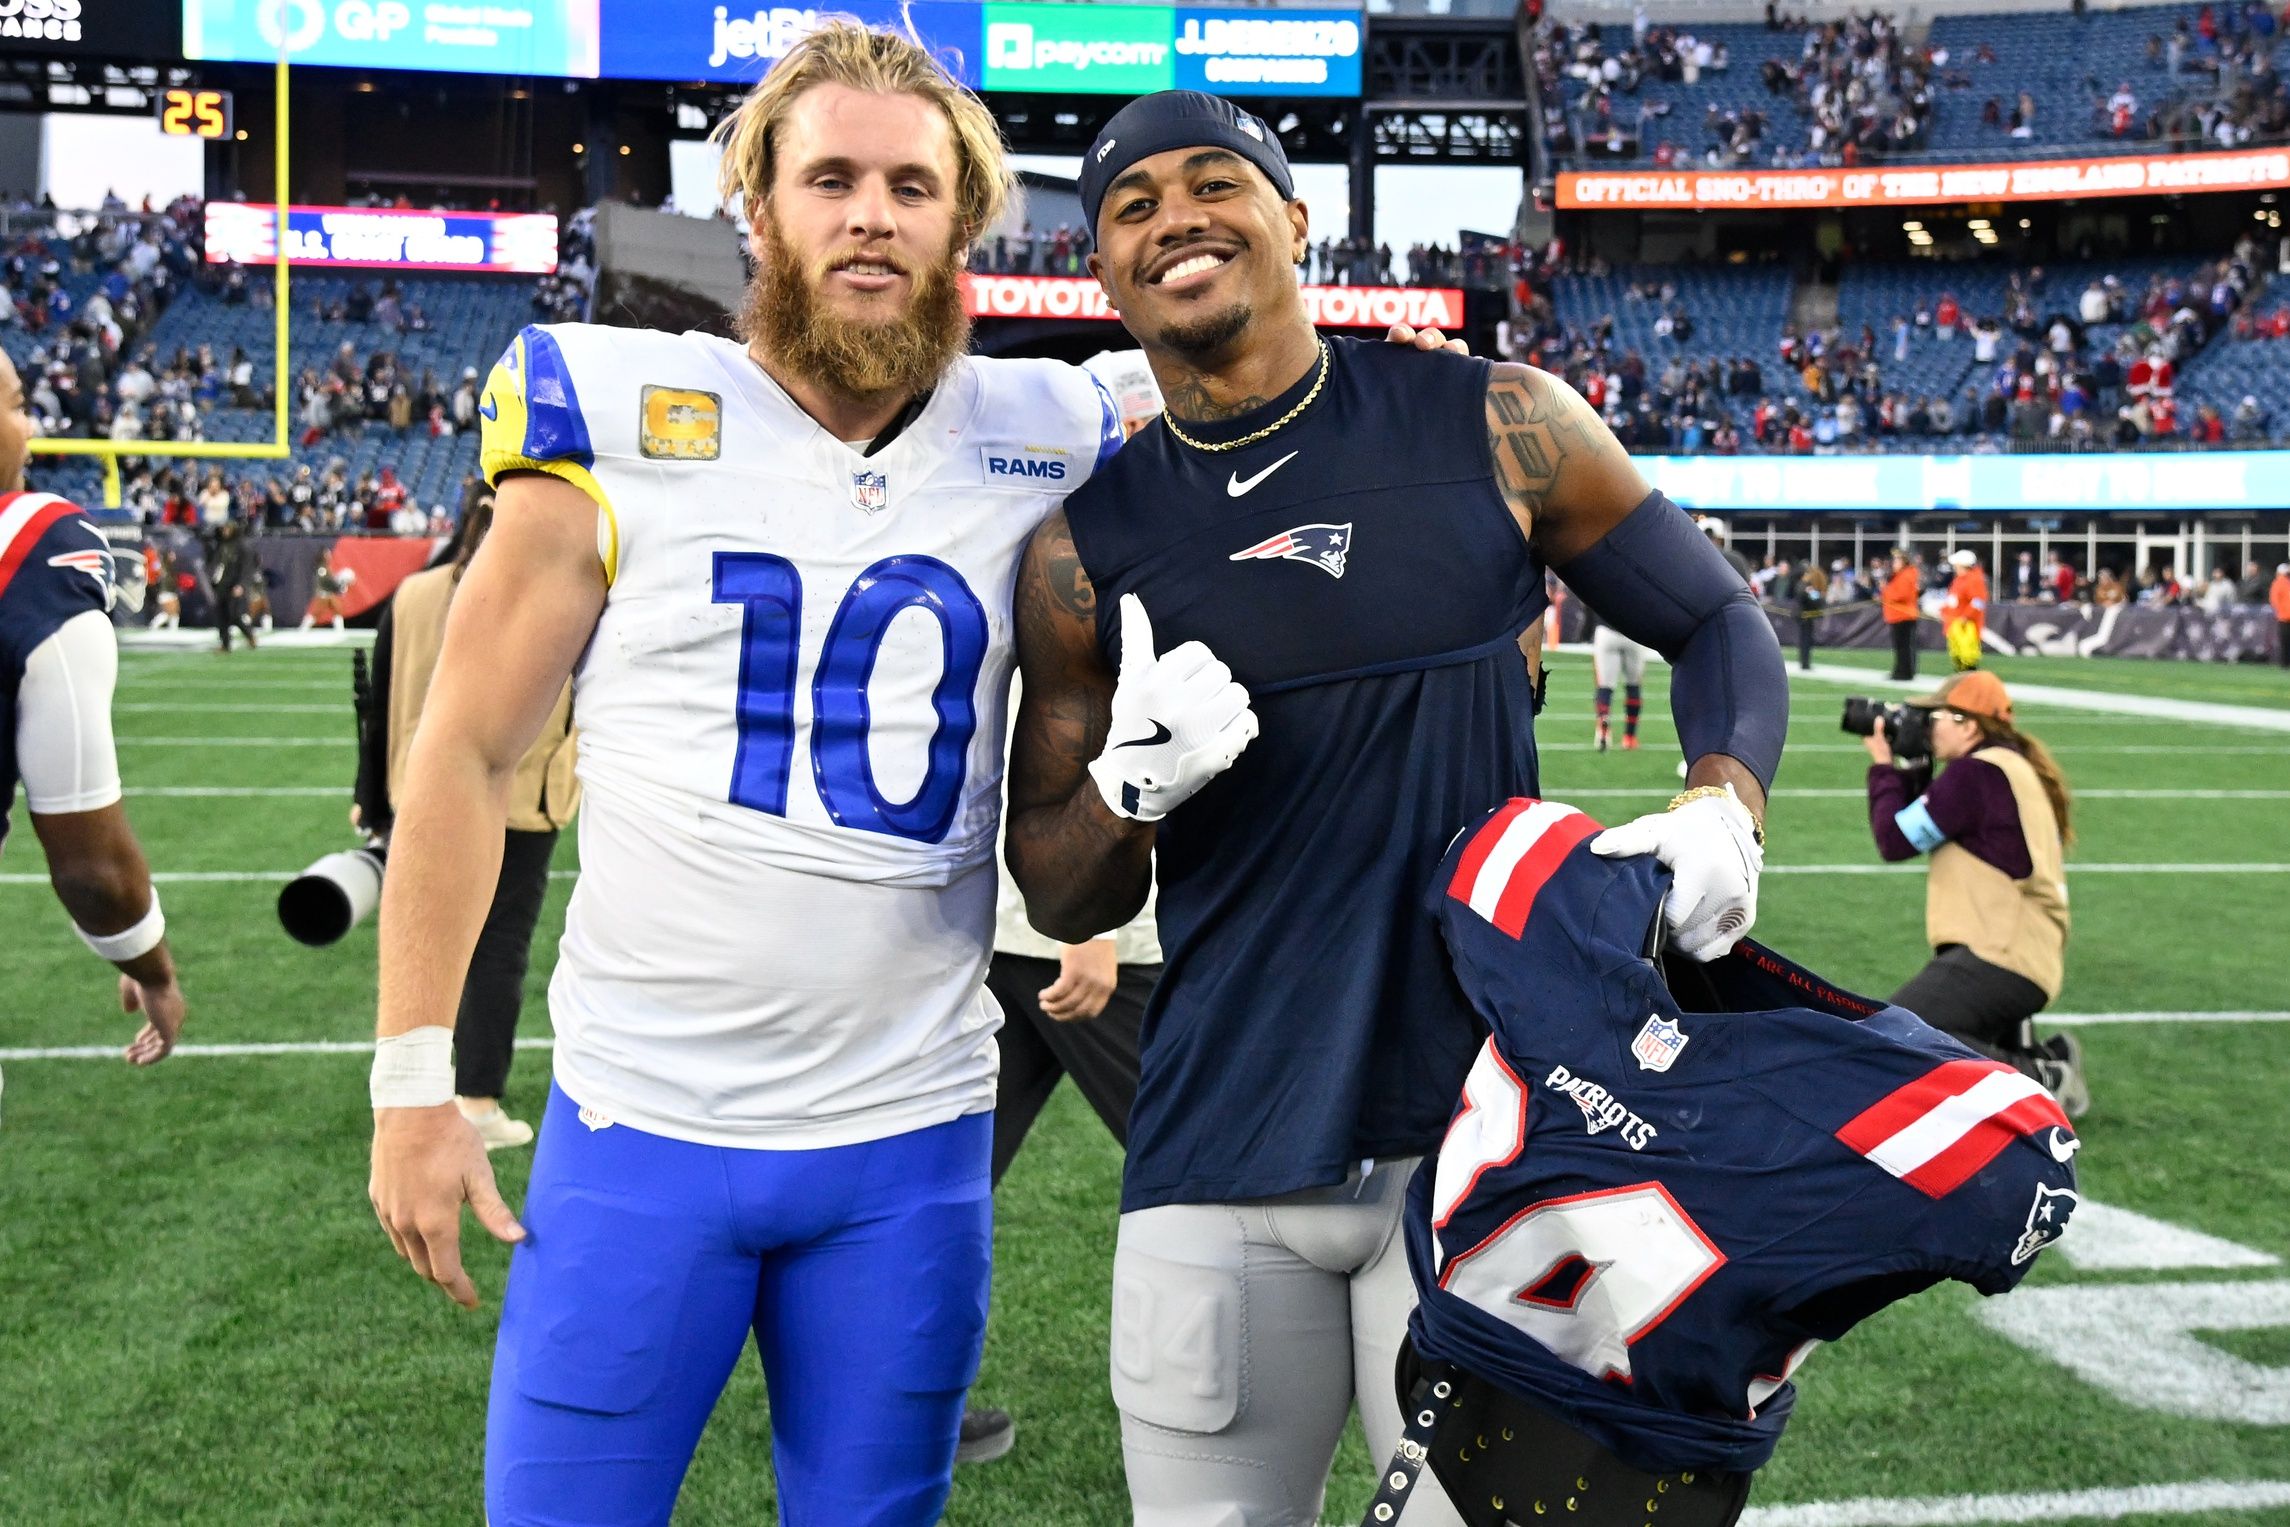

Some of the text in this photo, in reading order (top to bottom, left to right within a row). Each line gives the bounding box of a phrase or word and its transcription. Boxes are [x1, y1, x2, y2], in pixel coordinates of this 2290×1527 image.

[164, 90, 224, 137] 25
[1576, 178, 1692, 201] OFFICIAL
[1843, 174, 1878, 198] OF
[1301, 287, 1451, 326] TOYOTA
[988, 456, 1066, 480] RAMS
[711, 551, 989, 845] 10
[1639, 1034, 1670, 1065] NFL
[1544, 1064, 1658, 1151] PATRIOTS
